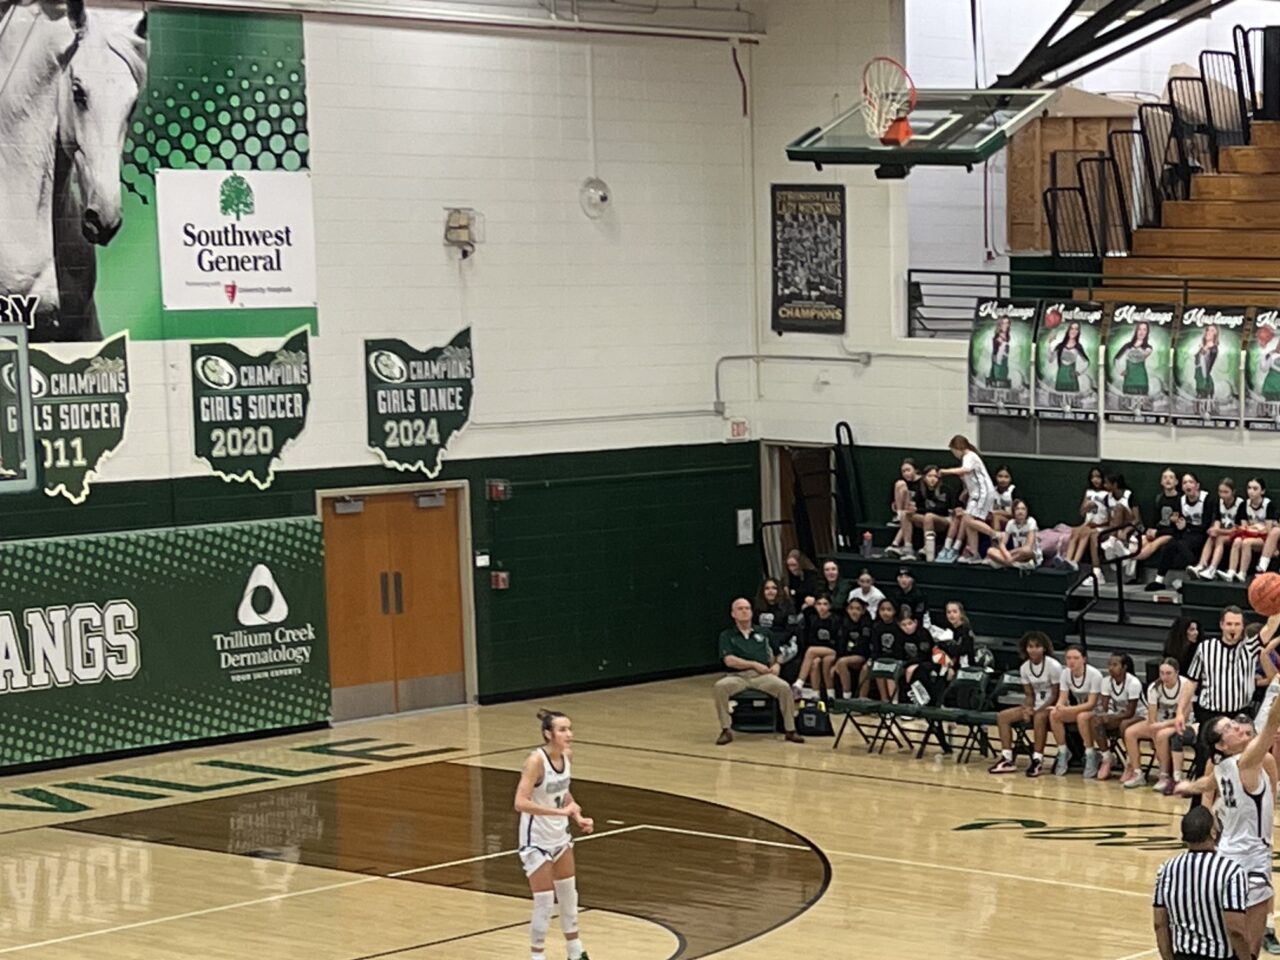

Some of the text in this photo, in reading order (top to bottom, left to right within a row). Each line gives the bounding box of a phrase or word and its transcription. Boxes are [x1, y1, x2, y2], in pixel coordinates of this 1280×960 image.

[183, 222, 293, 247] Southwest
[197, 248, 282, 272] General
[979, 301, 1036, 320] Mustangs
[1114, 305, 1174, 325] Mustangs
[1183, 308, 1244, 329] Mustangs
[240, 363, 308, 386] CHAMPIONS
[409, 358, 472, 380] CHAMPIONS
[51, 371, 126, 396] CHAMPIONS
[200, 394, 304, 422] GIRLS SOCCER
[377, 387, 464, 413] GIRLS DANCE
[7, 402, 121, 432] GLS SOCCER
[211, 425, 274, 458] 2020
[384, 417, 441, 448] 2024
[212, 624, 316, 651] Trillium Creek
[220, 643, 312, 669] Dermatology
